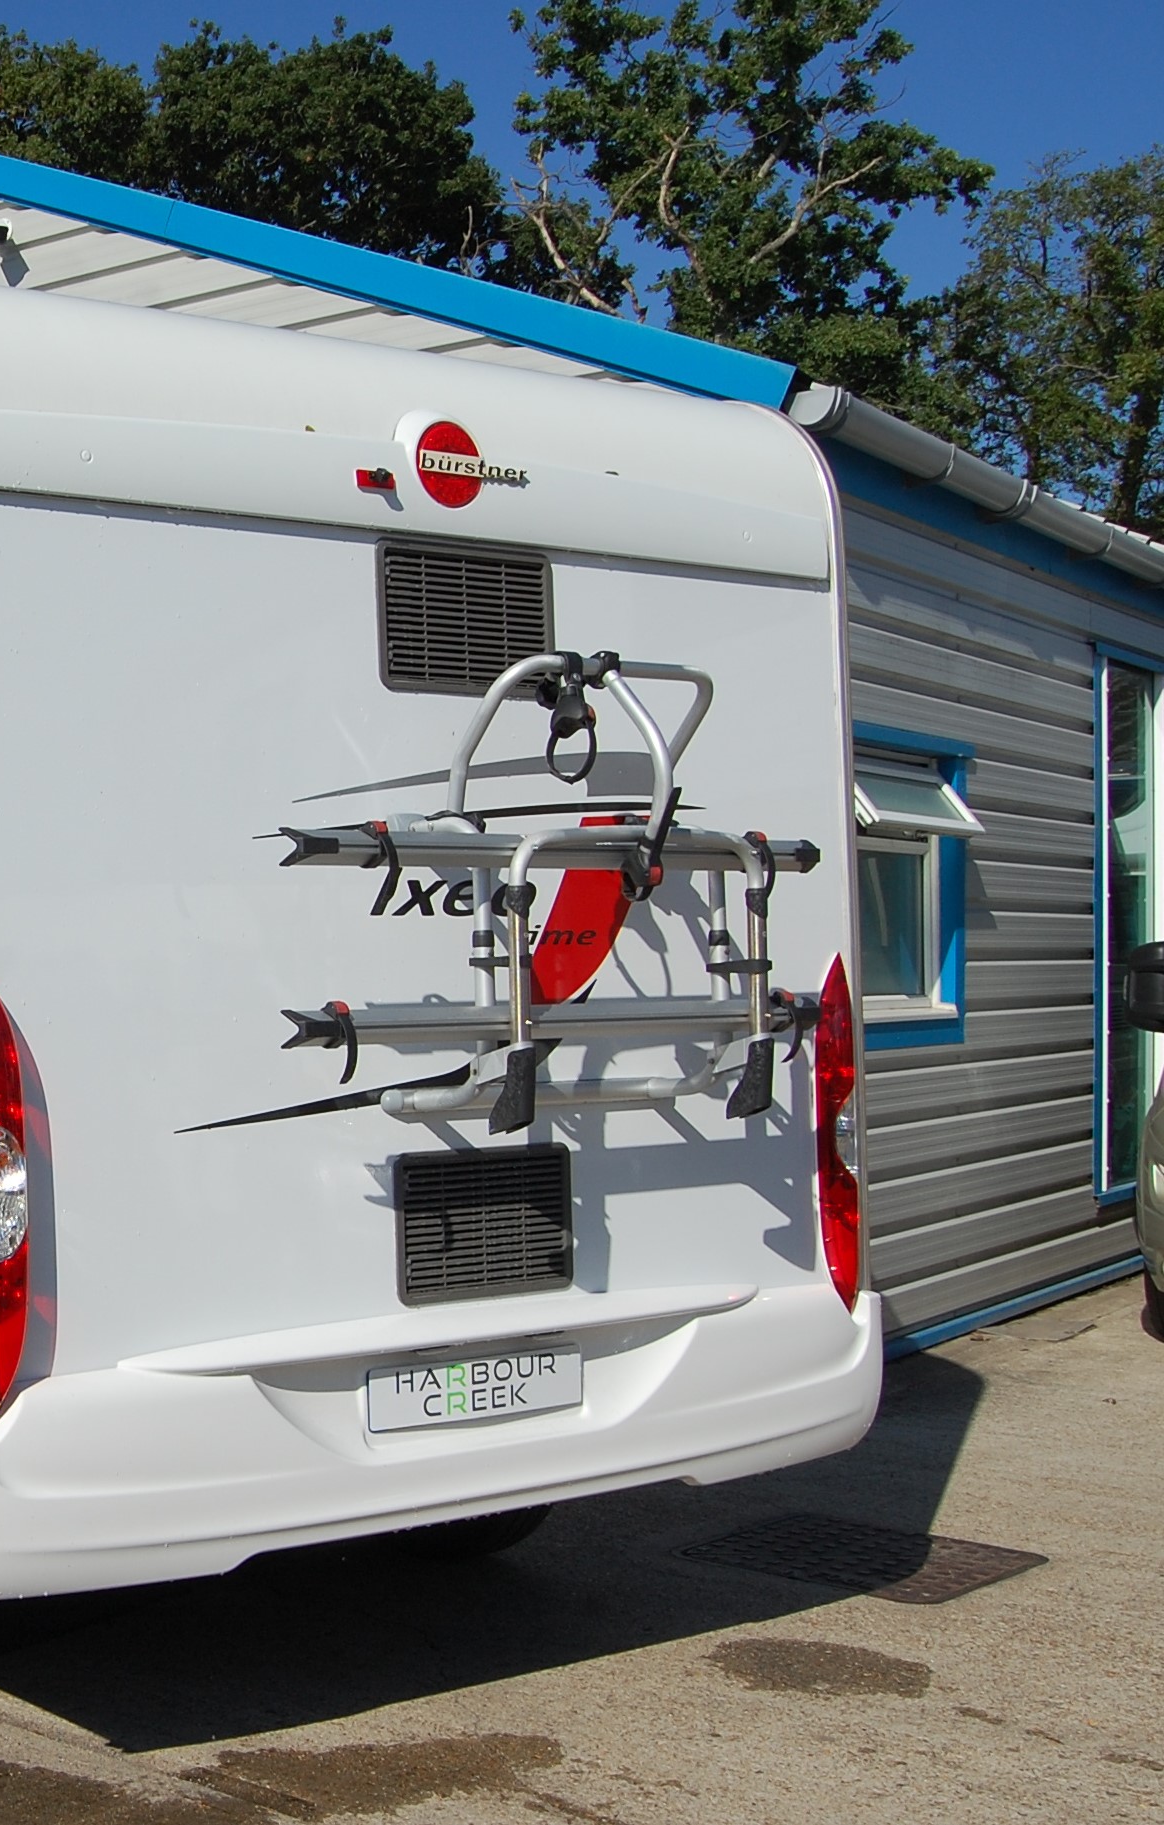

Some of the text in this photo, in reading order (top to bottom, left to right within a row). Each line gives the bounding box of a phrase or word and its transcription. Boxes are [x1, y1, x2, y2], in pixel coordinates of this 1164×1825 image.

[421, 453, 527, 480] bürstner
[527, 924, 597, 946] ime
[395, 1352, 556, 1394] HARBOUR
[423, 1382, 528, 1417] CREEK
